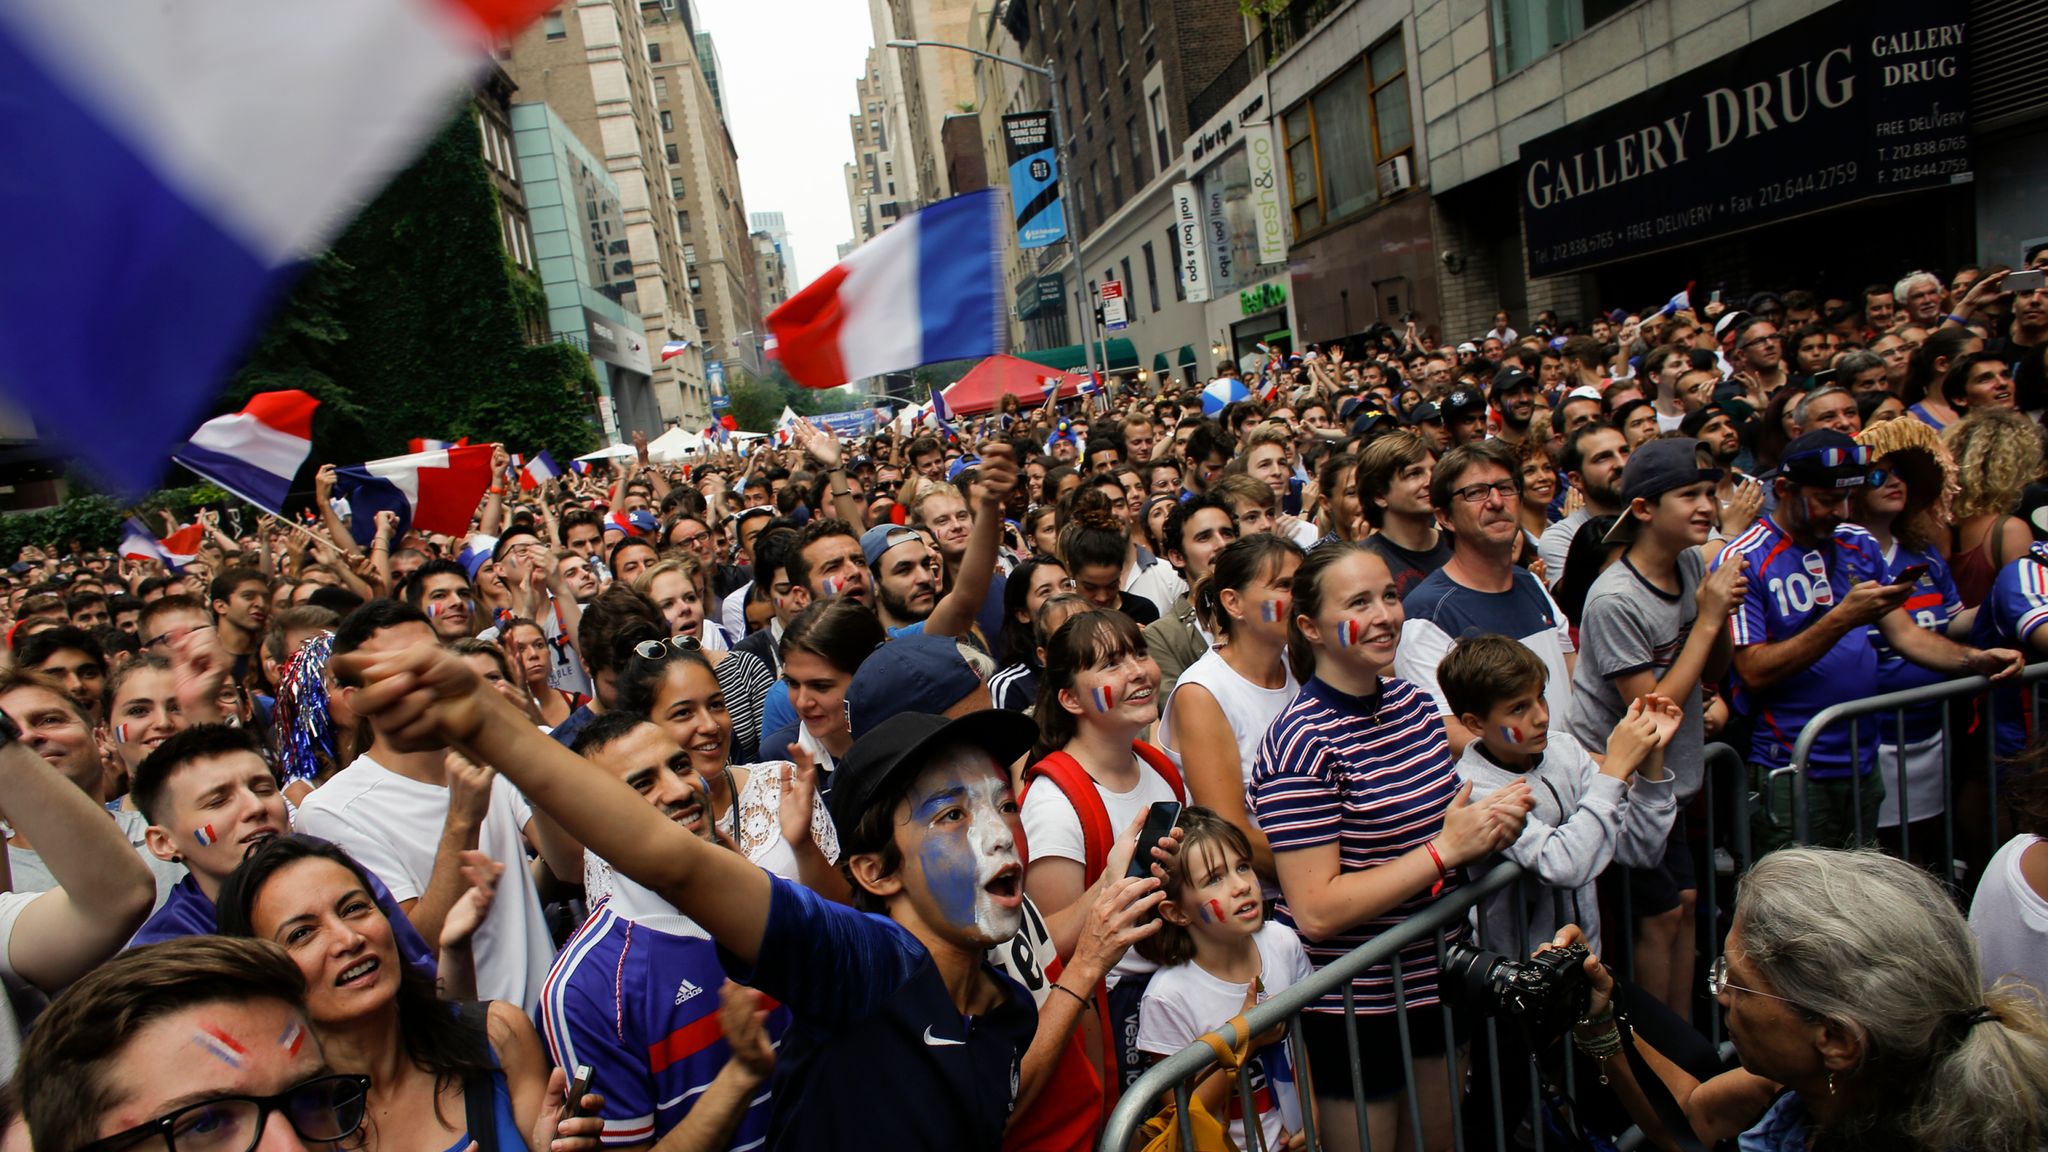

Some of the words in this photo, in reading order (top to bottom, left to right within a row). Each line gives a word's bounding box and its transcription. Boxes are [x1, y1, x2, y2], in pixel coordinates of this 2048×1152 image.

[1872, 23, 1966, 58] GALLERY
[1884, 56, 1957, 87] DRUG
[1019, 118, 1038, 129] YEARS
[1029, 126, 1047, 135] GOOD
[1527, 111, 1691, 209] GALLERY
[1703, 45, 1857, 153] DRUG
[1876, 120, 1905, 137] FREE
[1908, 110, 1966, 133] DELIVERY
[1014, 135, 1045, 145] TOGETHER
[1891, 135, 1967, 160] 212.838.6765
[1891, 158, 1967, 183] 212.644.2759
[1180, 197, 1194, 220] nail
[1626, 220, 1654, 243] FREE
[1656, 203, 1714, 236] DELIVERY
[1730, 194, 1754, 215] Fax
[1759, 160, 1858, 207] 212.644.2759
[1183, 224, 1195, 246] bar
[1185, 259, 1198, 282] spa
[1768, 572, 1816, 617] 10
[675, 986, 703, 1006] adidas
